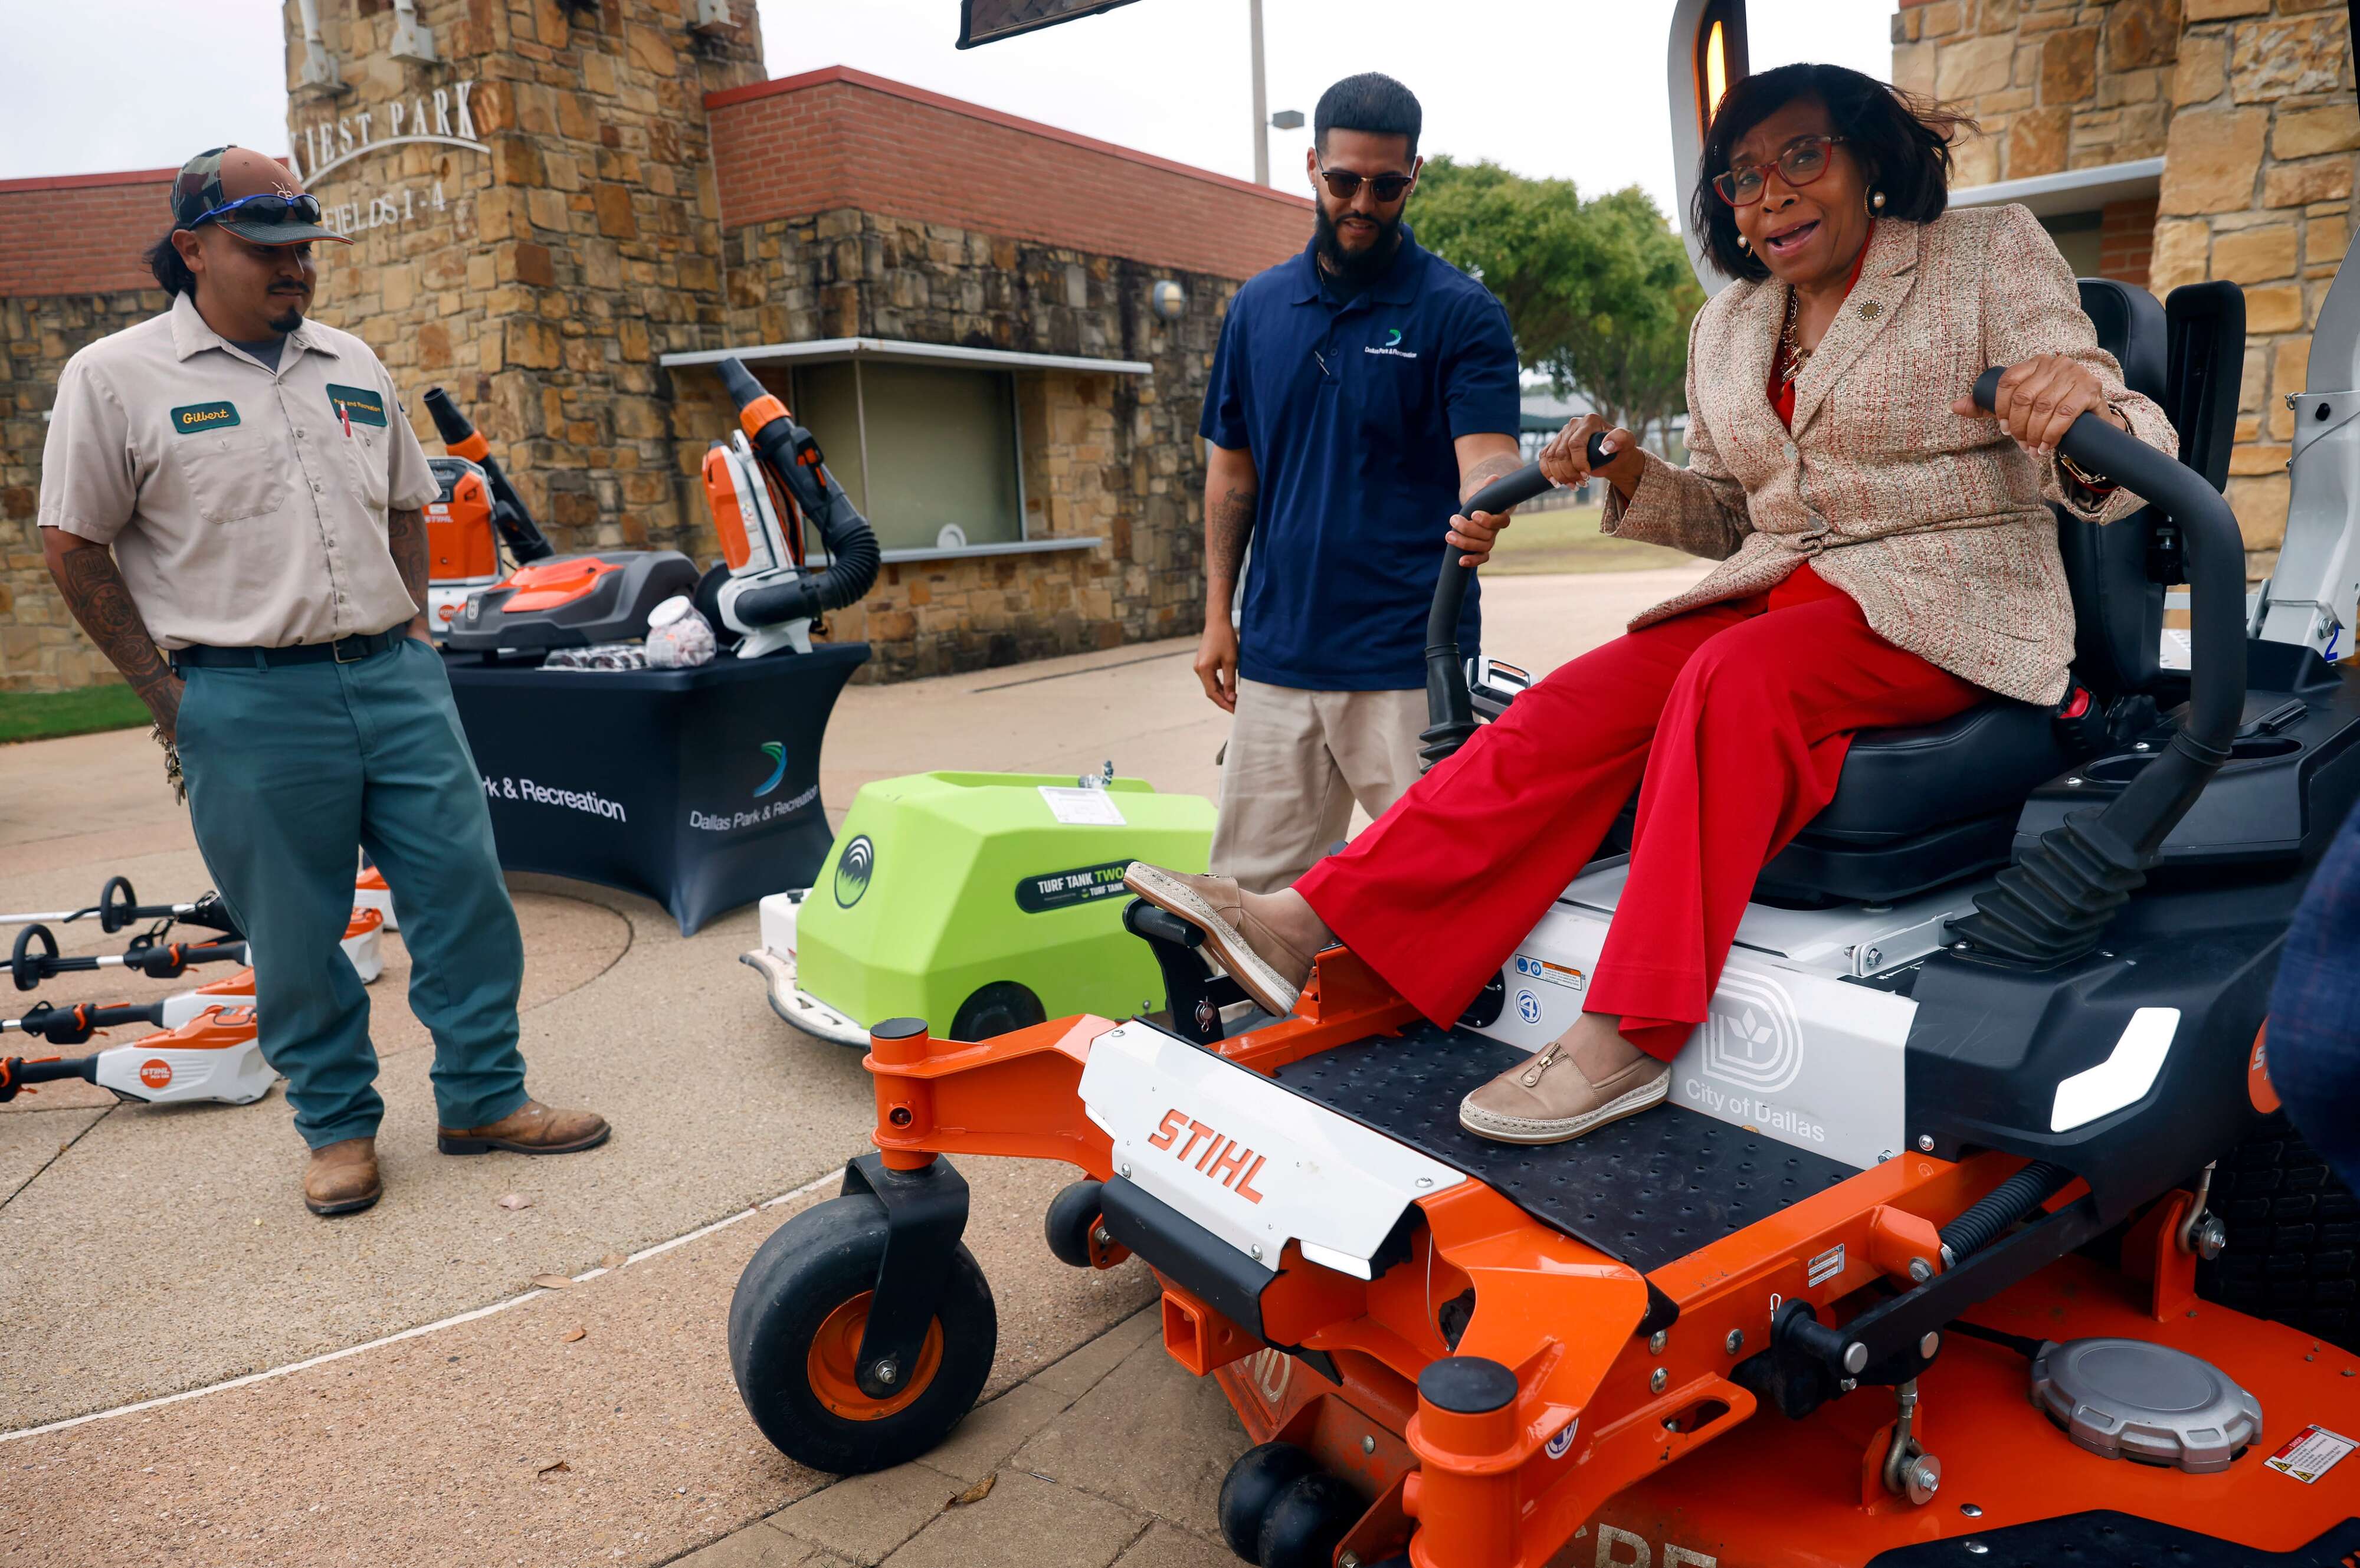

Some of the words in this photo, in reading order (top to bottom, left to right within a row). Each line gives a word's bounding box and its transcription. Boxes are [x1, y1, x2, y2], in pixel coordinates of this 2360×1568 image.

[289, 112, 372, 184] KIEST
[389, 81, 477, 141] PARK
[323, 193, 399, 235] FIELDS
[182, 408, 230, 424] Gilbert
[503, 777, 519, 799] &
[519, 779, 627, 822] Recreation
[689, 810, 732, 831] Dallas
[733, 809, 761, 828] Park
[762, 805, 772, 821] &
[773, 783, 819, 817] Recreation
[1037, 877, 1064, 894] TURF
[1066, 872, 1093, 889] TANK
[1094, 867, 1125, 883] TWO
[1089, 885, 1106, 896] TURF
[1107, 882, 1125, 893] TANK
[141, 1067, 170, 1076] STIHL
[1685, 1078, 1725, 1112] City
[1729, 1097, 1751, 1117] of
[1755, 1100, 1825, 1143] Dallas
[1147, 1108, 1268, 1206] STIHL
